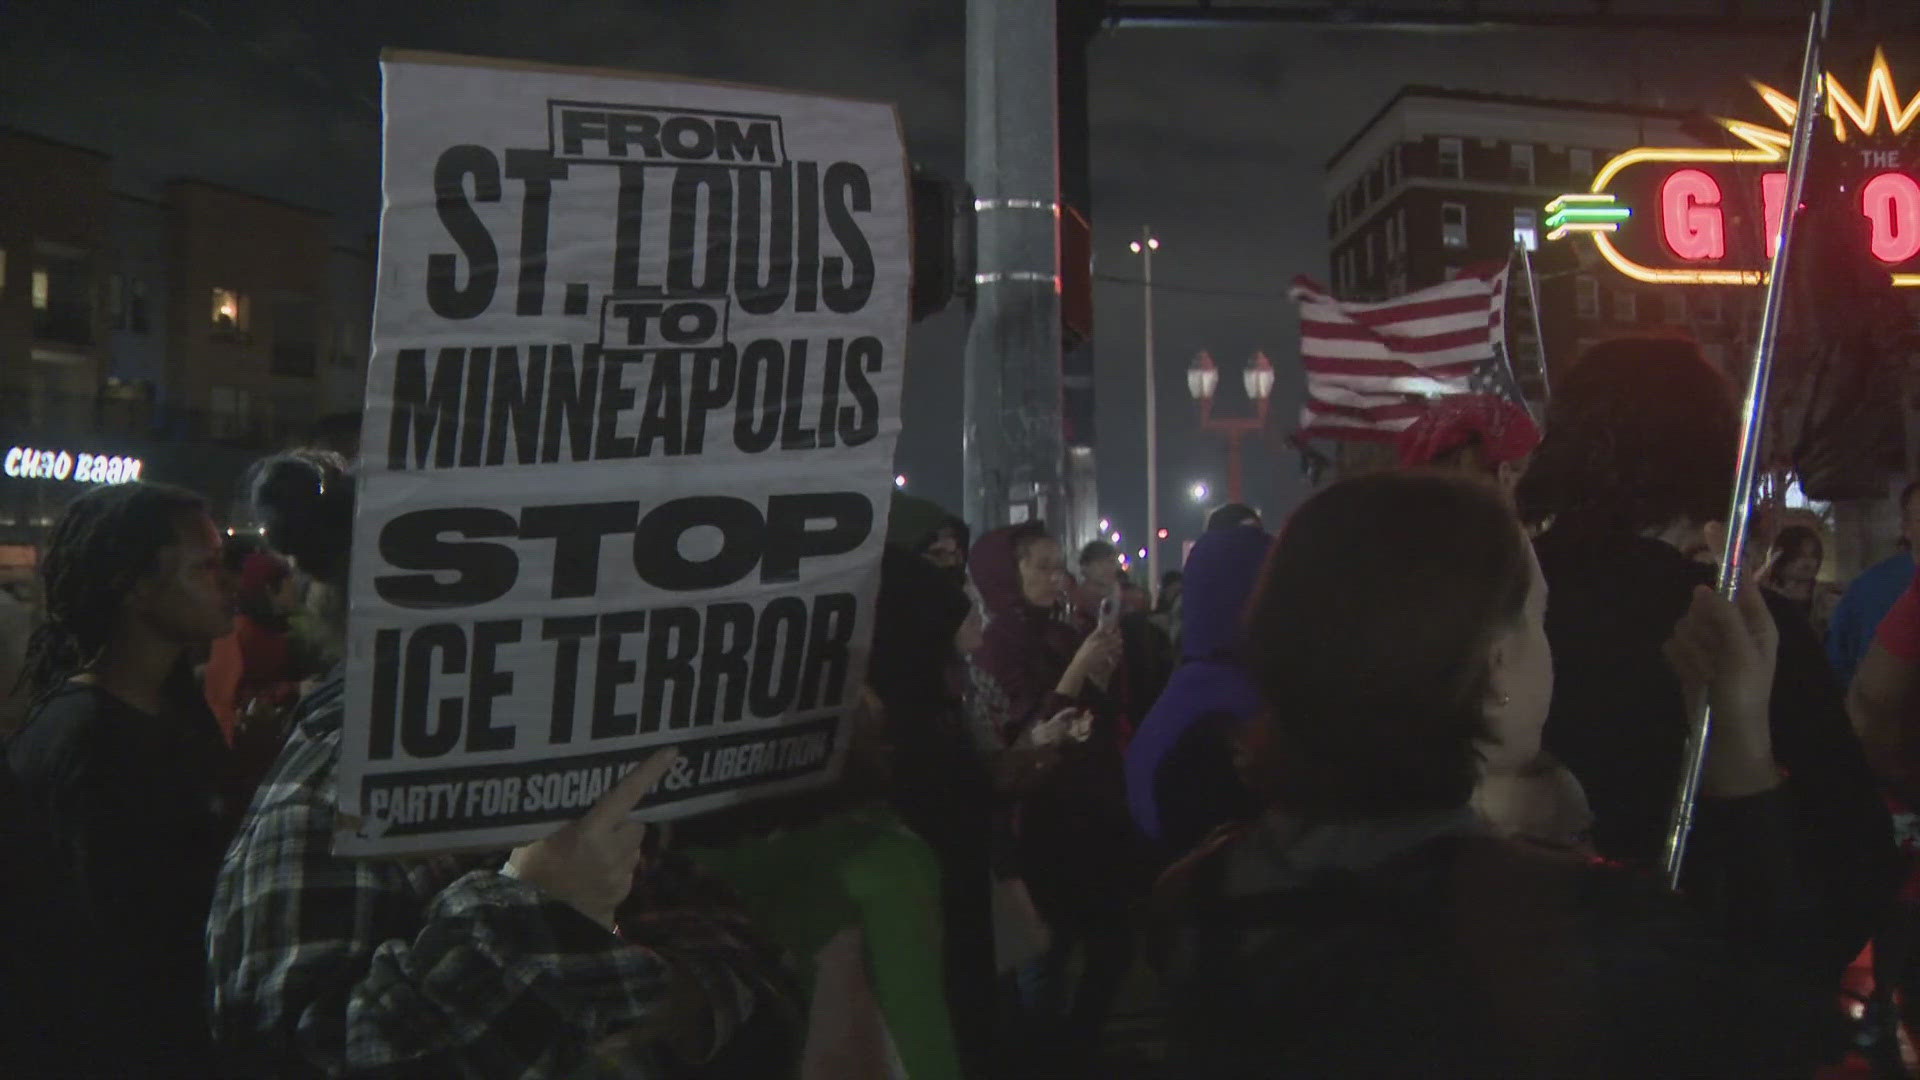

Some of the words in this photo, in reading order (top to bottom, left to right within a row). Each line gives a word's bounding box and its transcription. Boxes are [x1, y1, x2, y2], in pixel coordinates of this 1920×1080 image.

[562, 110, 776, 161] FROM
[1861, 150, 1899, 168] THE
[427, 145, 589, 320] ST.
[613, 158, 875, 315] LOUIS
[613, 303, 717, 346] TO
[388, 336, 883, 470] MINNEAPOLIS
[374, 492, 873, 609] STOP
[368, 620, 522, 760] ICE
[542, 593, 856, 744] TERROR
[369, 782, 463, 825] PARTY
[463, 776, 521, 818] FOR
[664, 755, 695, 791] &
